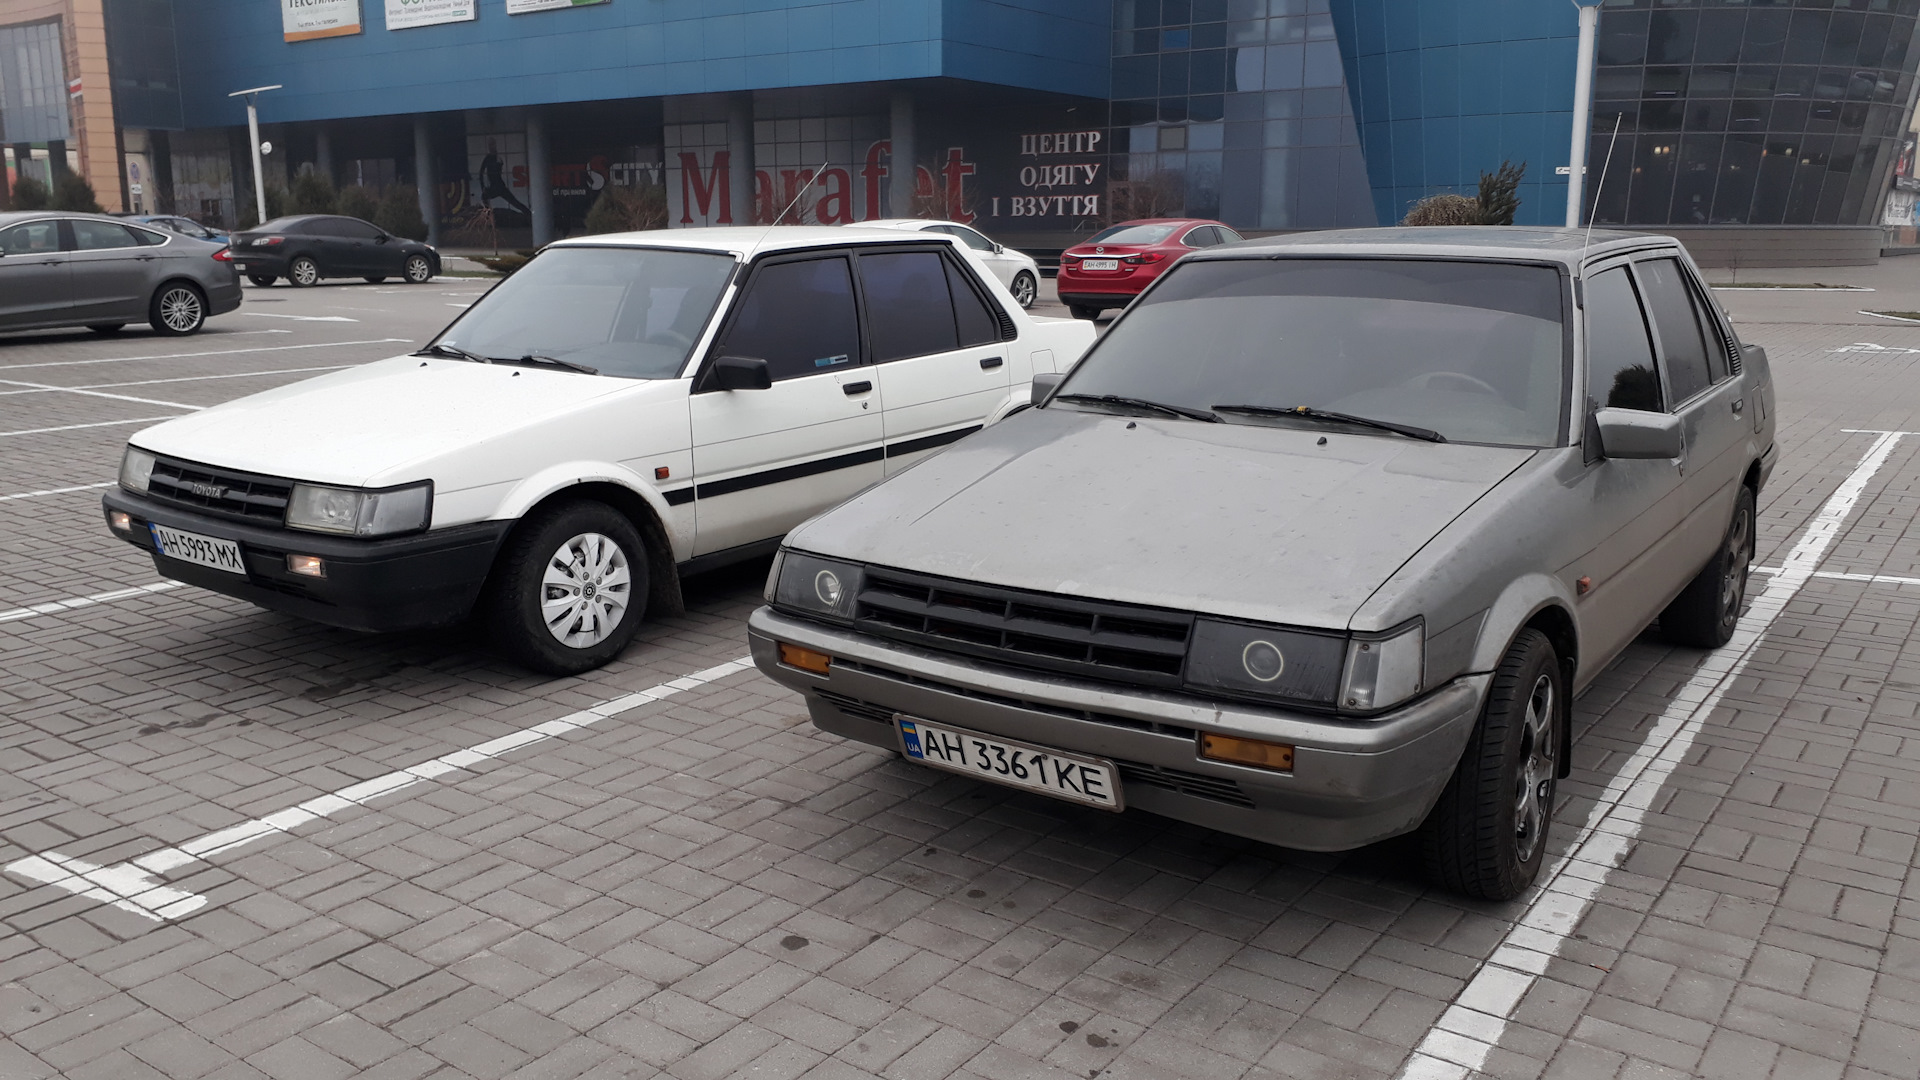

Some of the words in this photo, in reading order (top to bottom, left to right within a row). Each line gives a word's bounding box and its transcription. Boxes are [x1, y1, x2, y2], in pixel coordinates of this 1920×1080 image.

[1021, 131, 1101, 159] ЦЕНТР
[1020, 164, 1101, 190] ОДЯГУ
[1010, 194, 1099, 217] ВЗУТТЯ
[192, 484, 221, 498] TOYOTA
[907, 742, 921, 755] UA
[925, 730, 967, 765] AH
